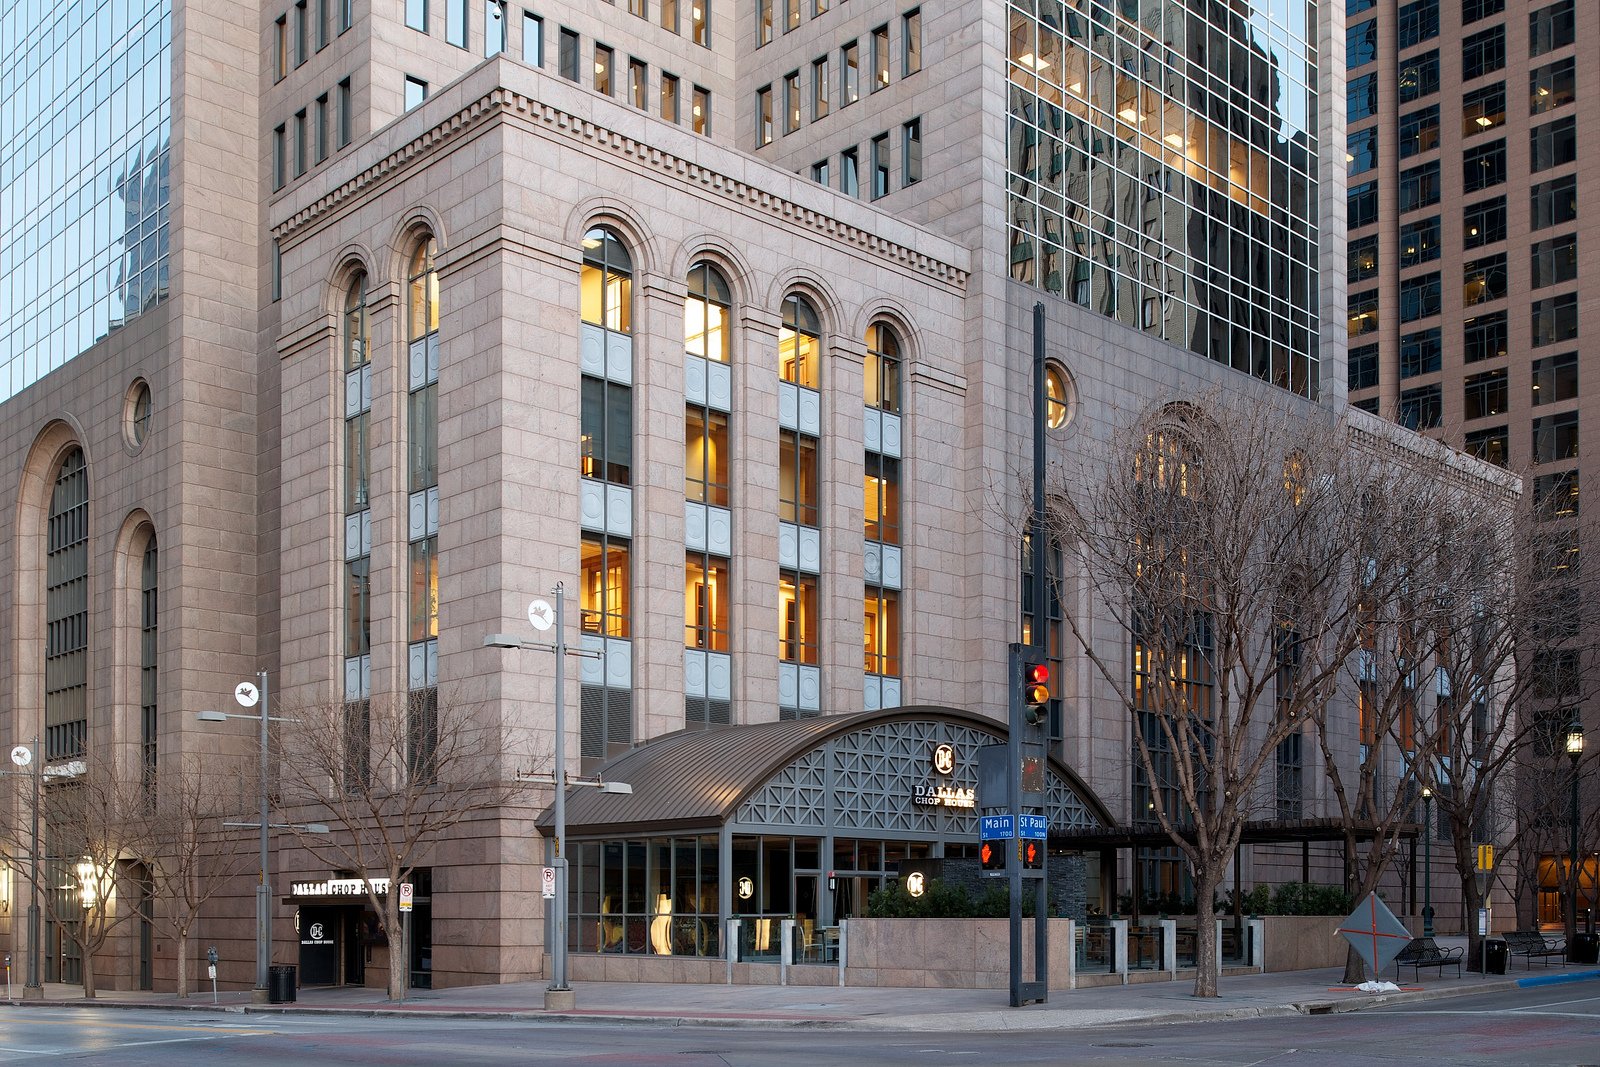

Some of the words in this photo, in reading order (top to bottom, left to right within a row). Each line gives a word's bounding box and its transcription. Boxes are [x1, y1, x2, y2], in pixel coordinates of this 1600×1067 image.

[915, 785, 975, 801] DALLAS
[915, 797, 941, 806] CHOP
[985, 817, 1010, 829] Main
[1020, 817, 1028, 828] St
[1030, 817, 1046, 829] Paul
[292, 883, 328, 896] DALLAS
[331, 883, 356, 895] CHOP
[360, 882, 389, 895] HUS
